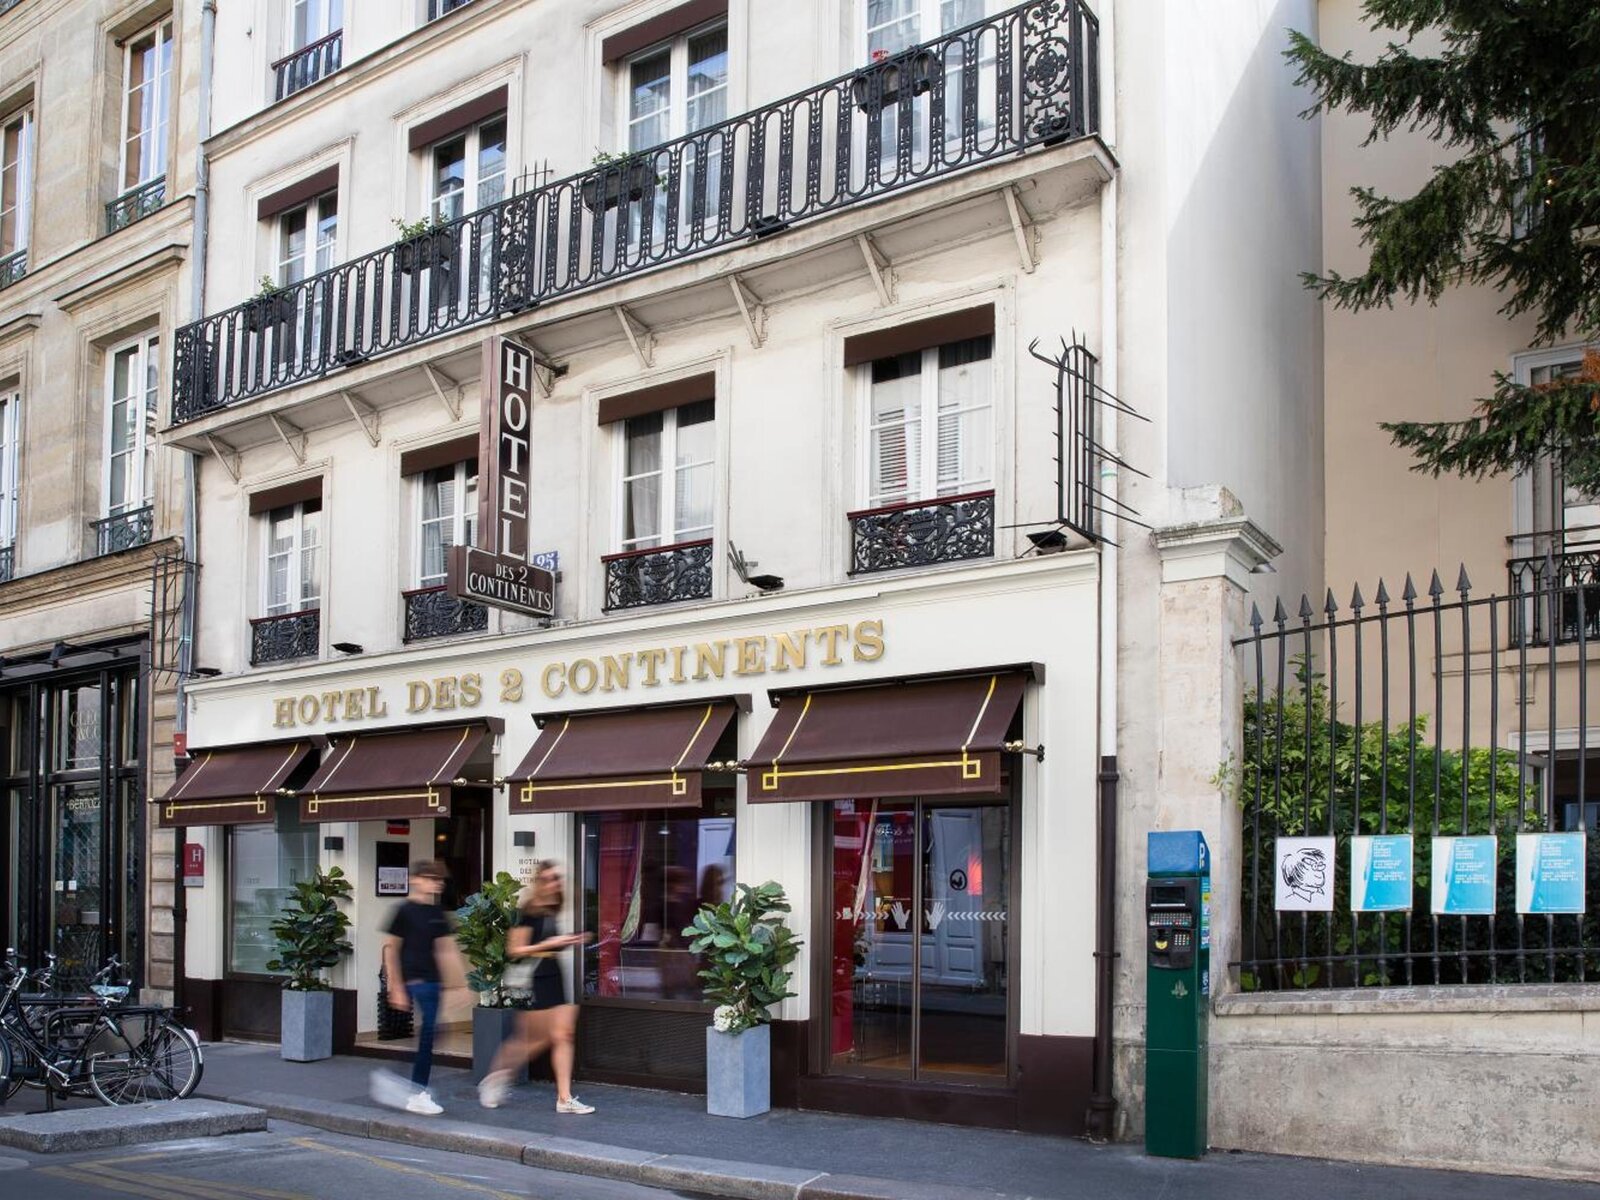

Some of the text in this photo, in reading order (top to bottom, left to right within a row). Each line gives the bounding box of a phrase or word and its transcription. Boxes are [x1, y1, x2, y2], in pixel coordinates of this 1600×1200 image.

[501, 346, 528, 560] HOTEL
[469, 572, 552, 610] CONTINENTS
[496, 563, 528, 584] DES 2
[273, 618, 885, 728] HOTEL DES 2 CONTINENTS
[192, 849, 202, 862] H
